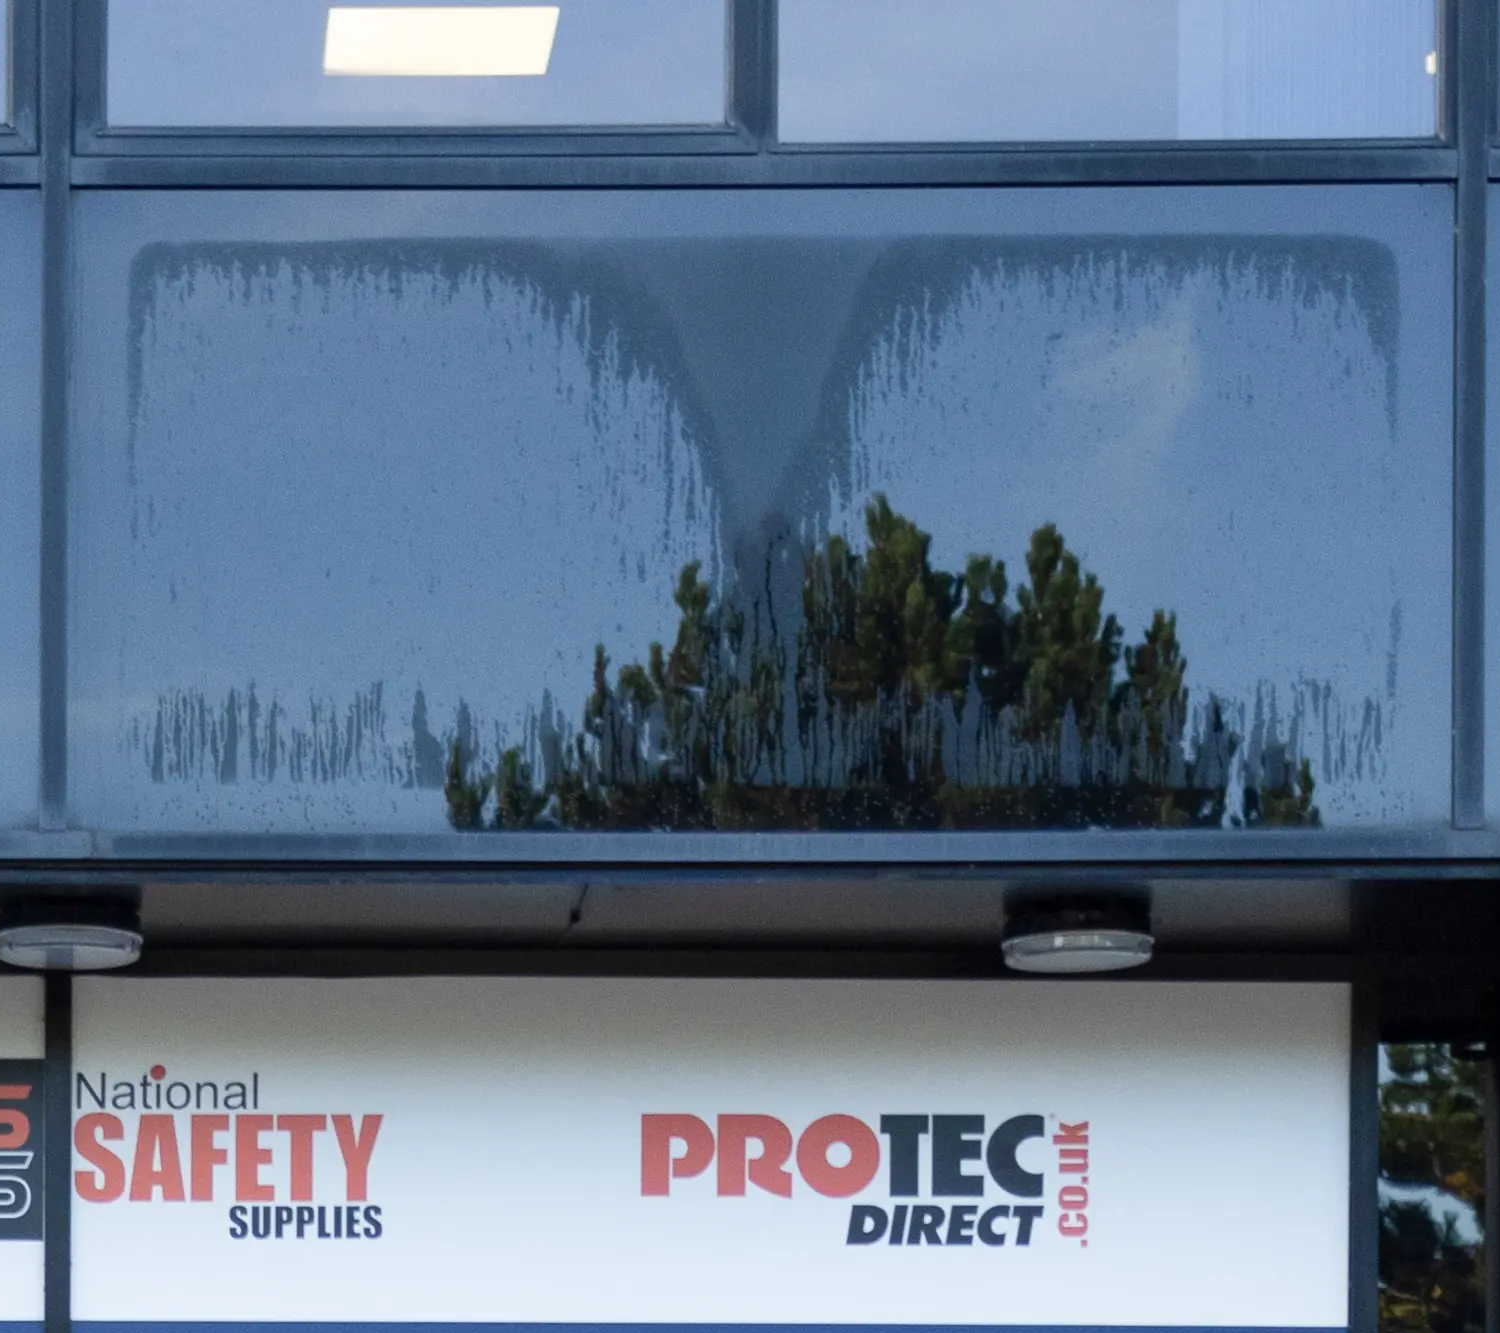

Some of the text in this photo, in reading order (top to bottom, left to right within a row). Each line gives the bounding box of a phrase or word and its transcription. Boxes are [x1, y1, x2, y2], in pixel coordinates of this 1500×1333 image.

[75, 1064, 260, 1111] National
[74, 1112, 384, 1203] SAFETY
[640, 1113, 1046, 1198] PROTEC
[1053, 1119, 1090, 1248] .co.uk
[229, 1205, 383, 1239] SUPPLIES
[846, 1204, 1045, 1247] DIRECT
